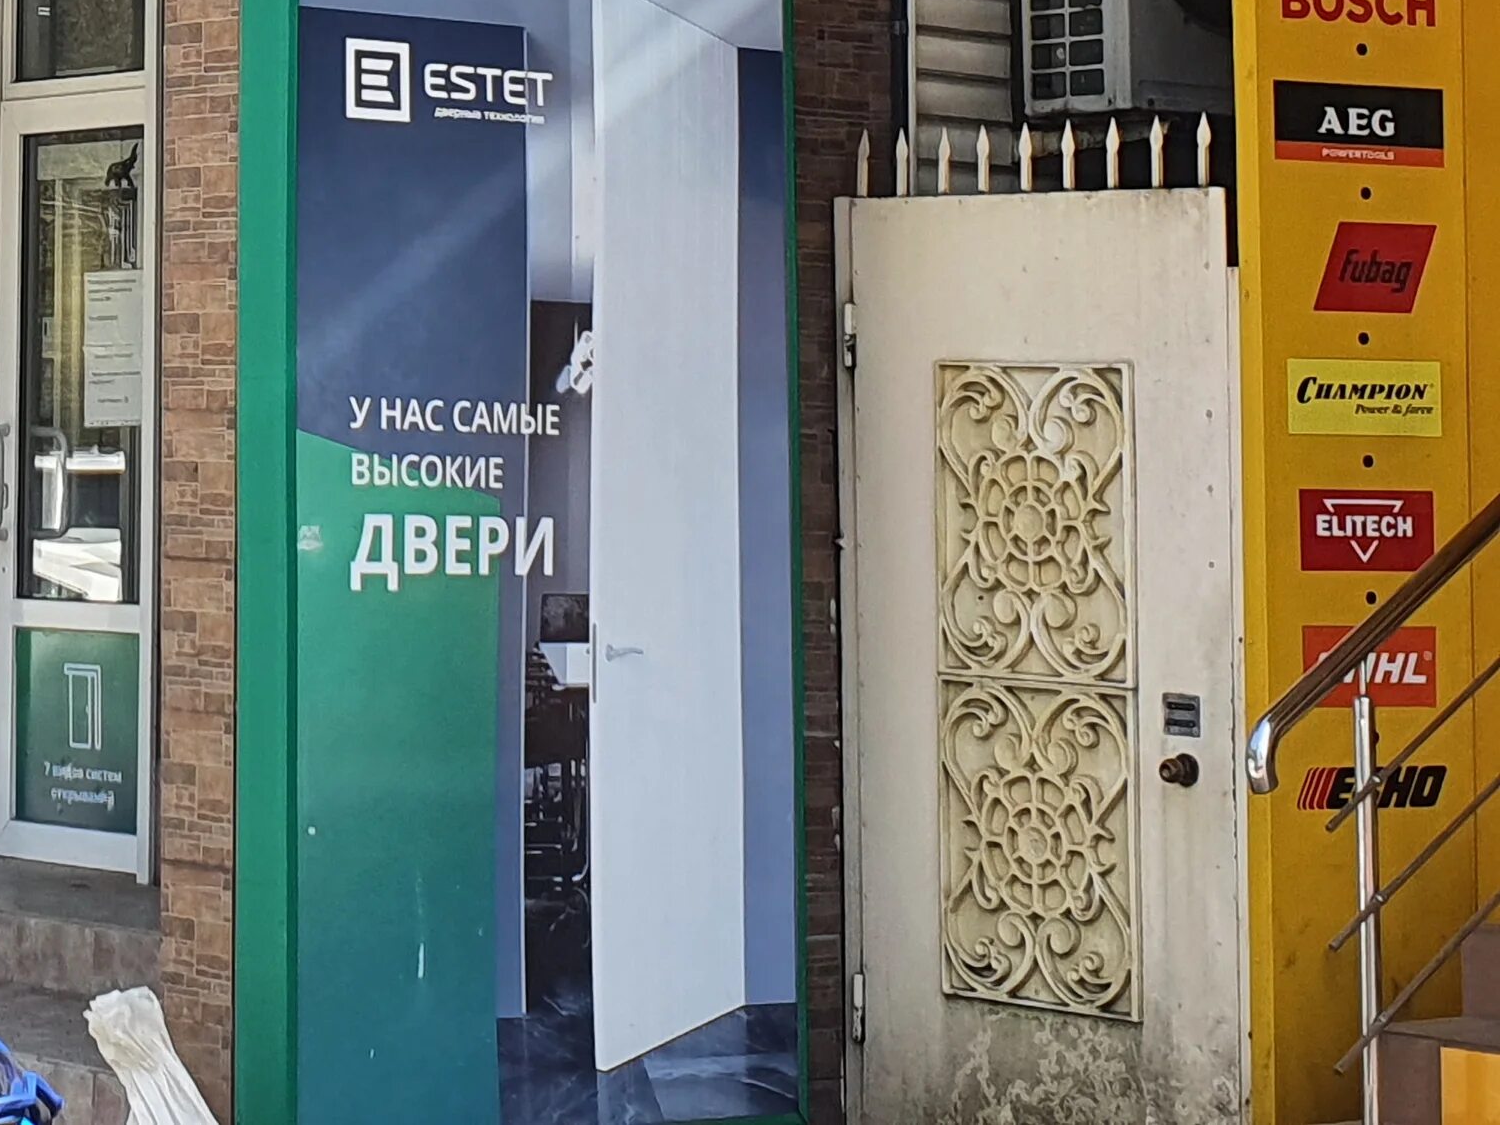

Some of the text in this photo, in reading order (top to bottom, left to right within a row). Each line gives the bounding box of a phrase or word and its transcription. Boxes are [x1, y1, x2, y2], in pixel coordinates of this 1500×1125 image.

[424, 62, 553, 107] ESTET
[1317, 106, 1395, 137] AEG
[349, 396, 561, 435] У НАС САМЫЕ
[1355, 404, 1389, 416] Power
[351, 452, 504, 489] ВЫСОКИЕ
[1316, 514, 1414, 537] ELITECH
[350, 513, 554, 592] ДВЕРИ
